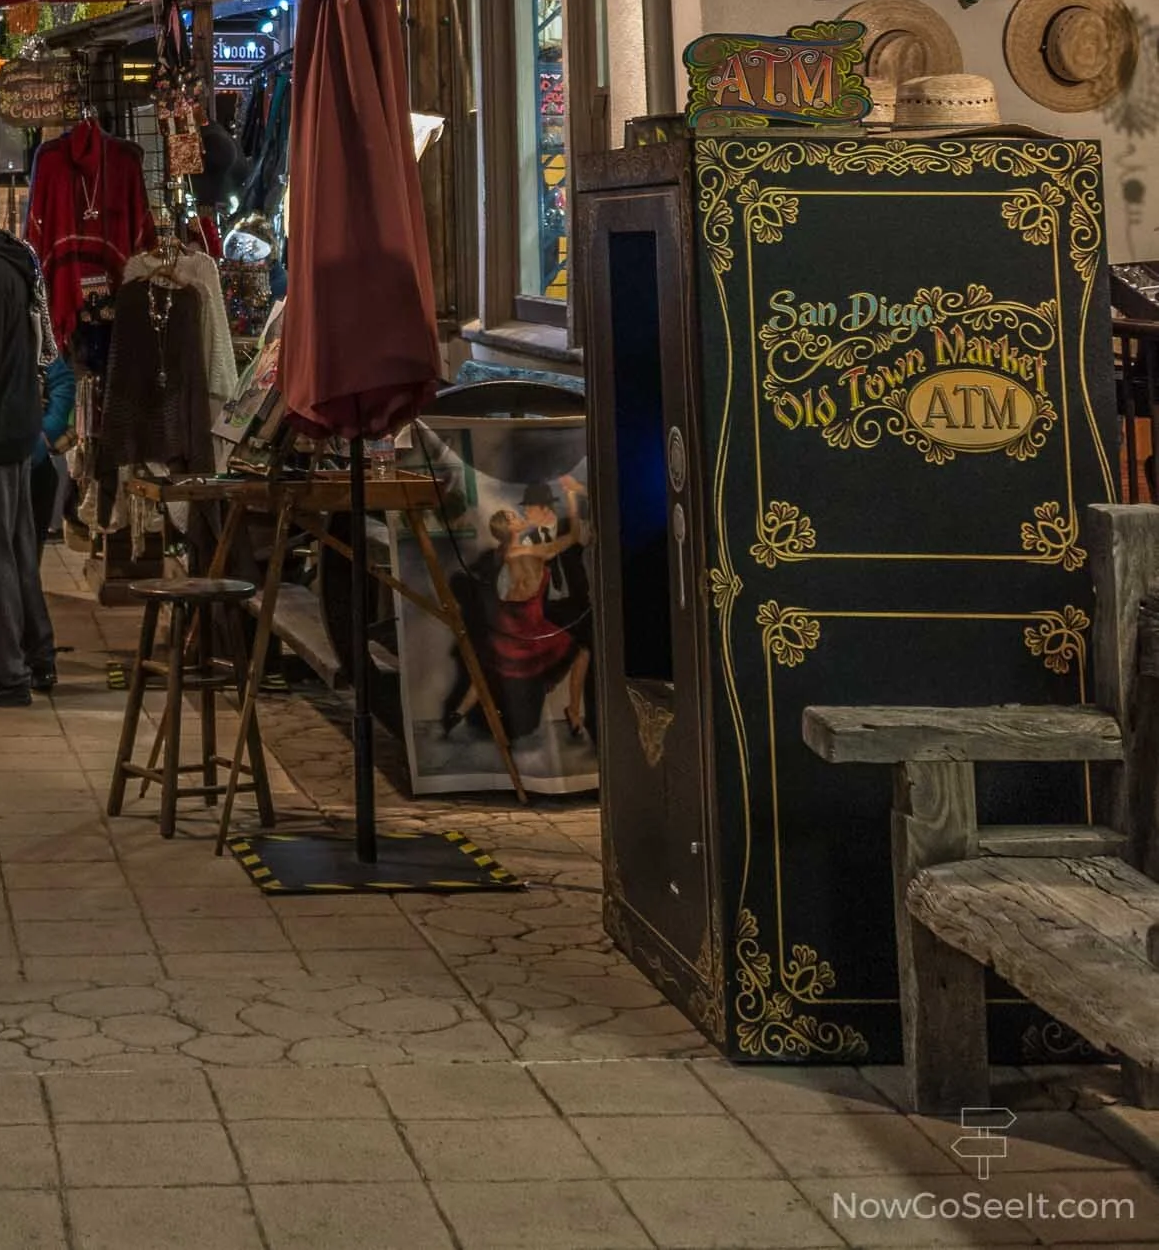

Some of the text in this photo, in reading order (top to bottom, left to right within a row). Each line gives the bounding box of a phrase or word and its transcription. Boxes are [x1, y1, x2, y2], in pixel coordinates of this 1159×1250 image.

[707, 47, 836, 108] ATM
[768, 290, 935, 343] San Diego
[773, 323, 1049, 431] Old Town Market
[921, 384, 1020, 431] ATM
